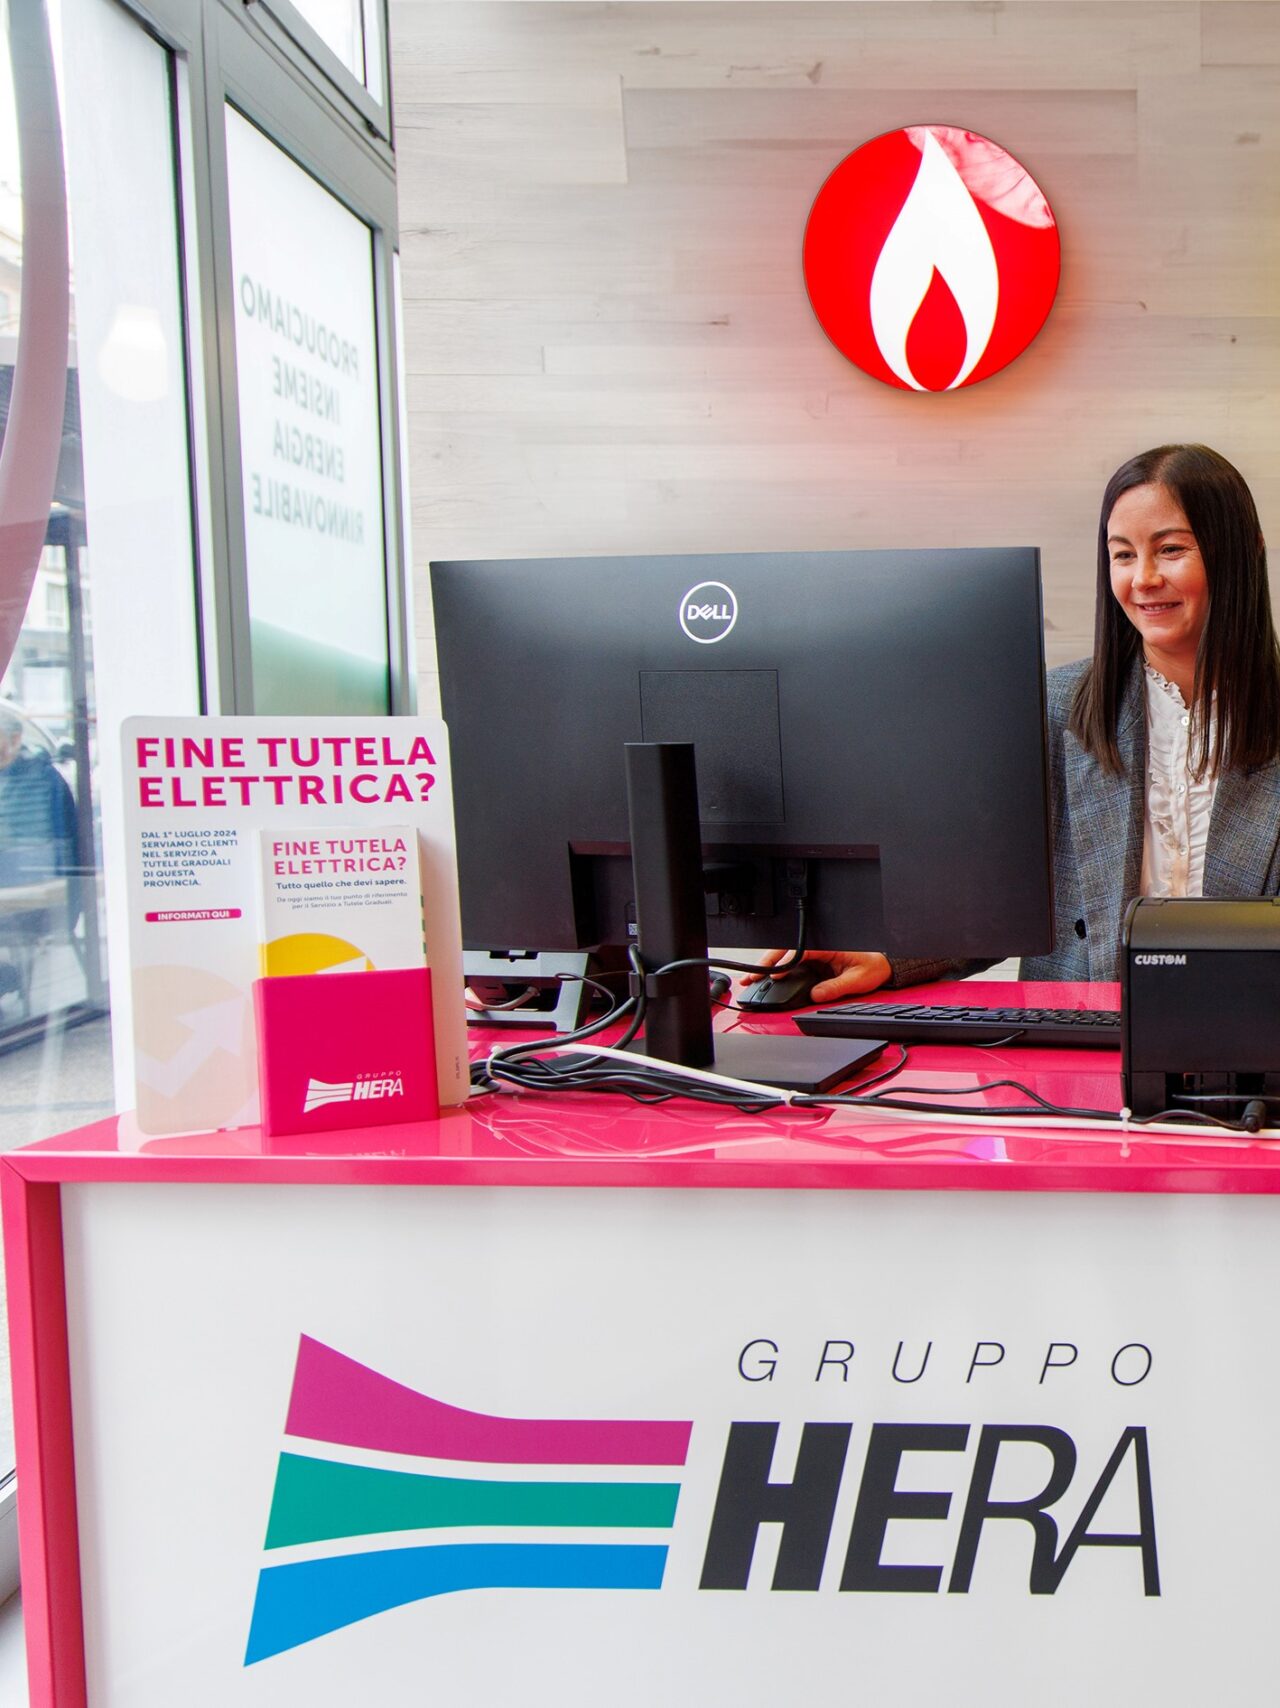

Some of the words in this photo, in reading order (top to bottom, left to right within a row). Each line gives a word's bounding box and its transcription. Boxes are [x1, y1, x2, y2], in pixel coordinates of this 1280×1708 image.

[687, 604, 731, 620] DELL
[136, 737, 246, 768] FINE
[257, 737, 437, 767] TUTELA
[139, 772, 436, 807] ELETTRICA?
[175, 830, 211, 838] LUGLIO
[272, 841, 320, 856] FINE
[326, 838, 407, 854] TUTELA
[143, 860, 179, 868] TUTELE
[181, 859, 231, 867] GRADUALI
[274, 857, 407, 875] ELETTRICA?
[276, 882, 302, 890] Tutto
[304, 881, 333, 890] quello
[158, 911, 209, 920] INFORMATI
[211, 910, 230, 918] QUI
[1135, 954, 1187, 966] CUSTOM
[357, 1070, 402, 1080] GRUPPO
[353, 1078, 404, 1100] HERA
[738, 1339, 1152, 1386] GRUPPO
[698, 1421, 1161, 1597] HERA
